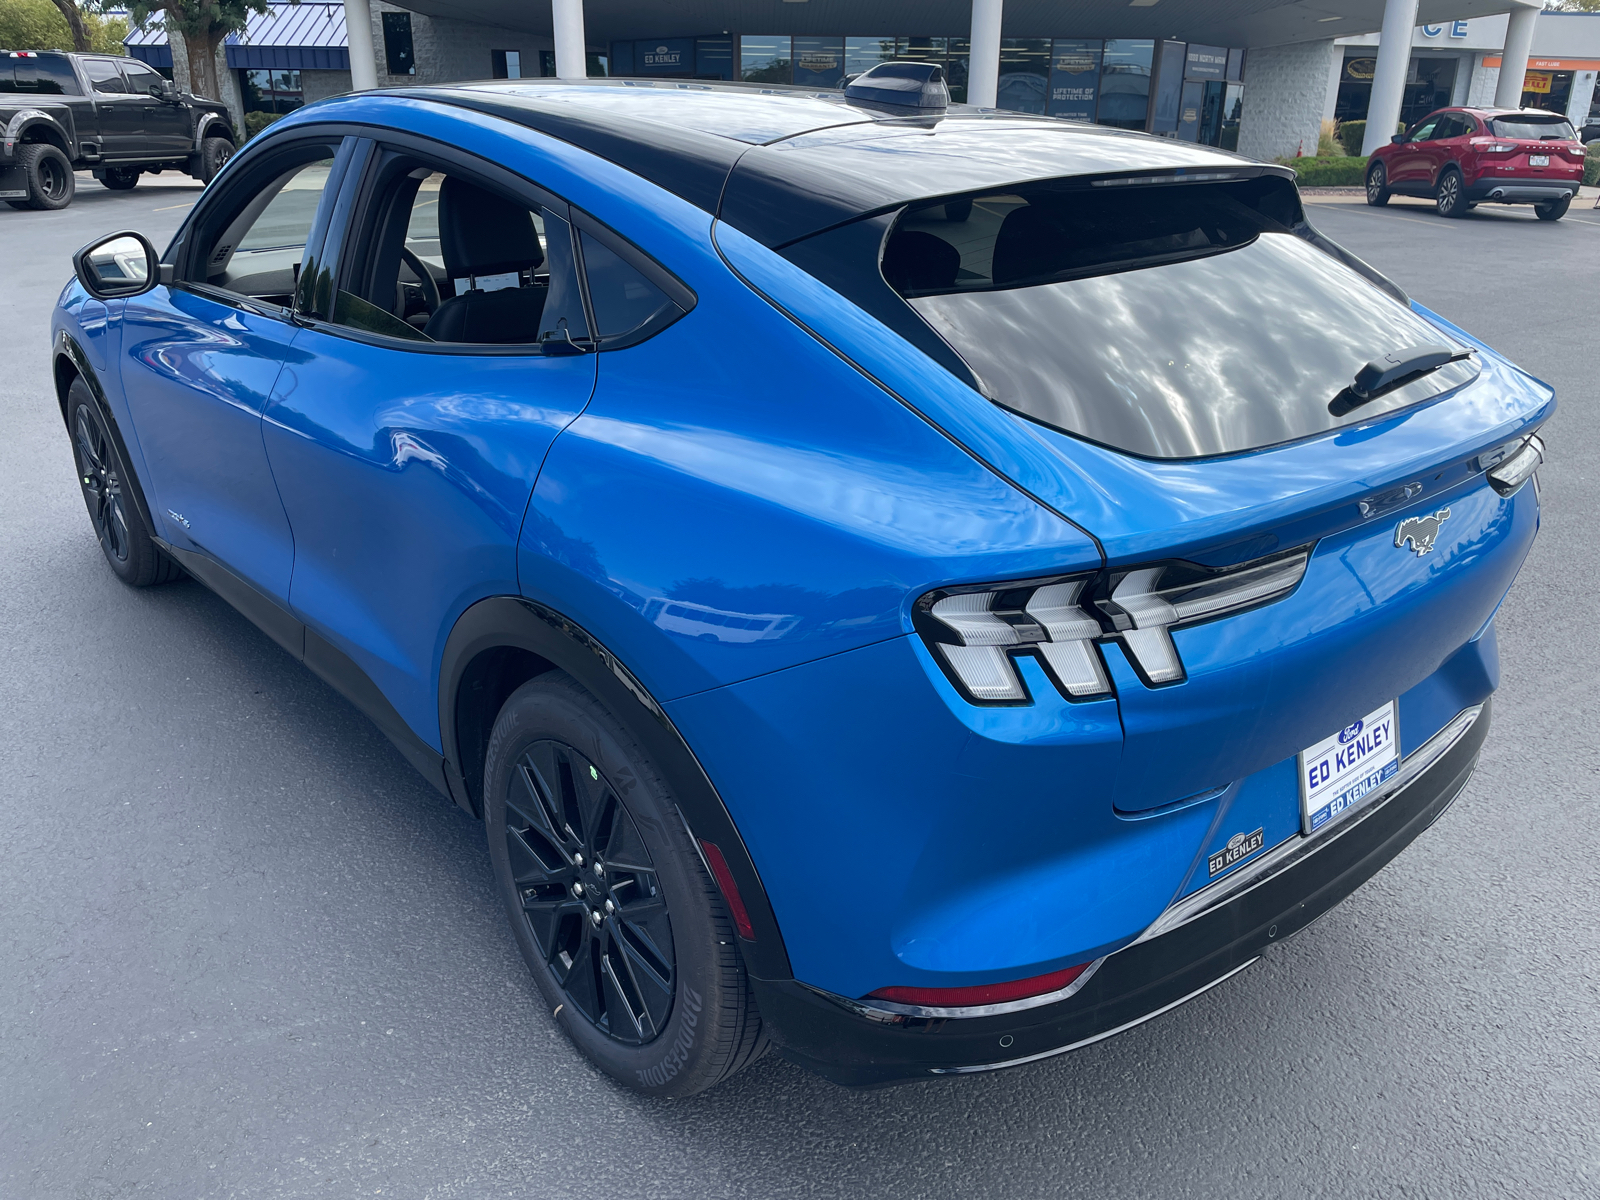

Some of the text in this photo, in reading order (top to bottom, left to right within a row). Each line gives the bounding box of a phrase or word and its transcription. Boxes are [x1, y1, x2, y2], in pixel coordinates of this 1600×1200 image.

[644, 54, 680, 63] ED KENLEY
[1524, 80, 1547, 89] ELLI
[1308, 719, 1391, 789] ED KENLEY
[1330, 796, 1345, 817] ED
[1346, 769, 1384, 806] KENLEY
[1209, 832, 1263, 873] ED KENLEY
[636, 981, 703, 1088] BRIDGESTONE
